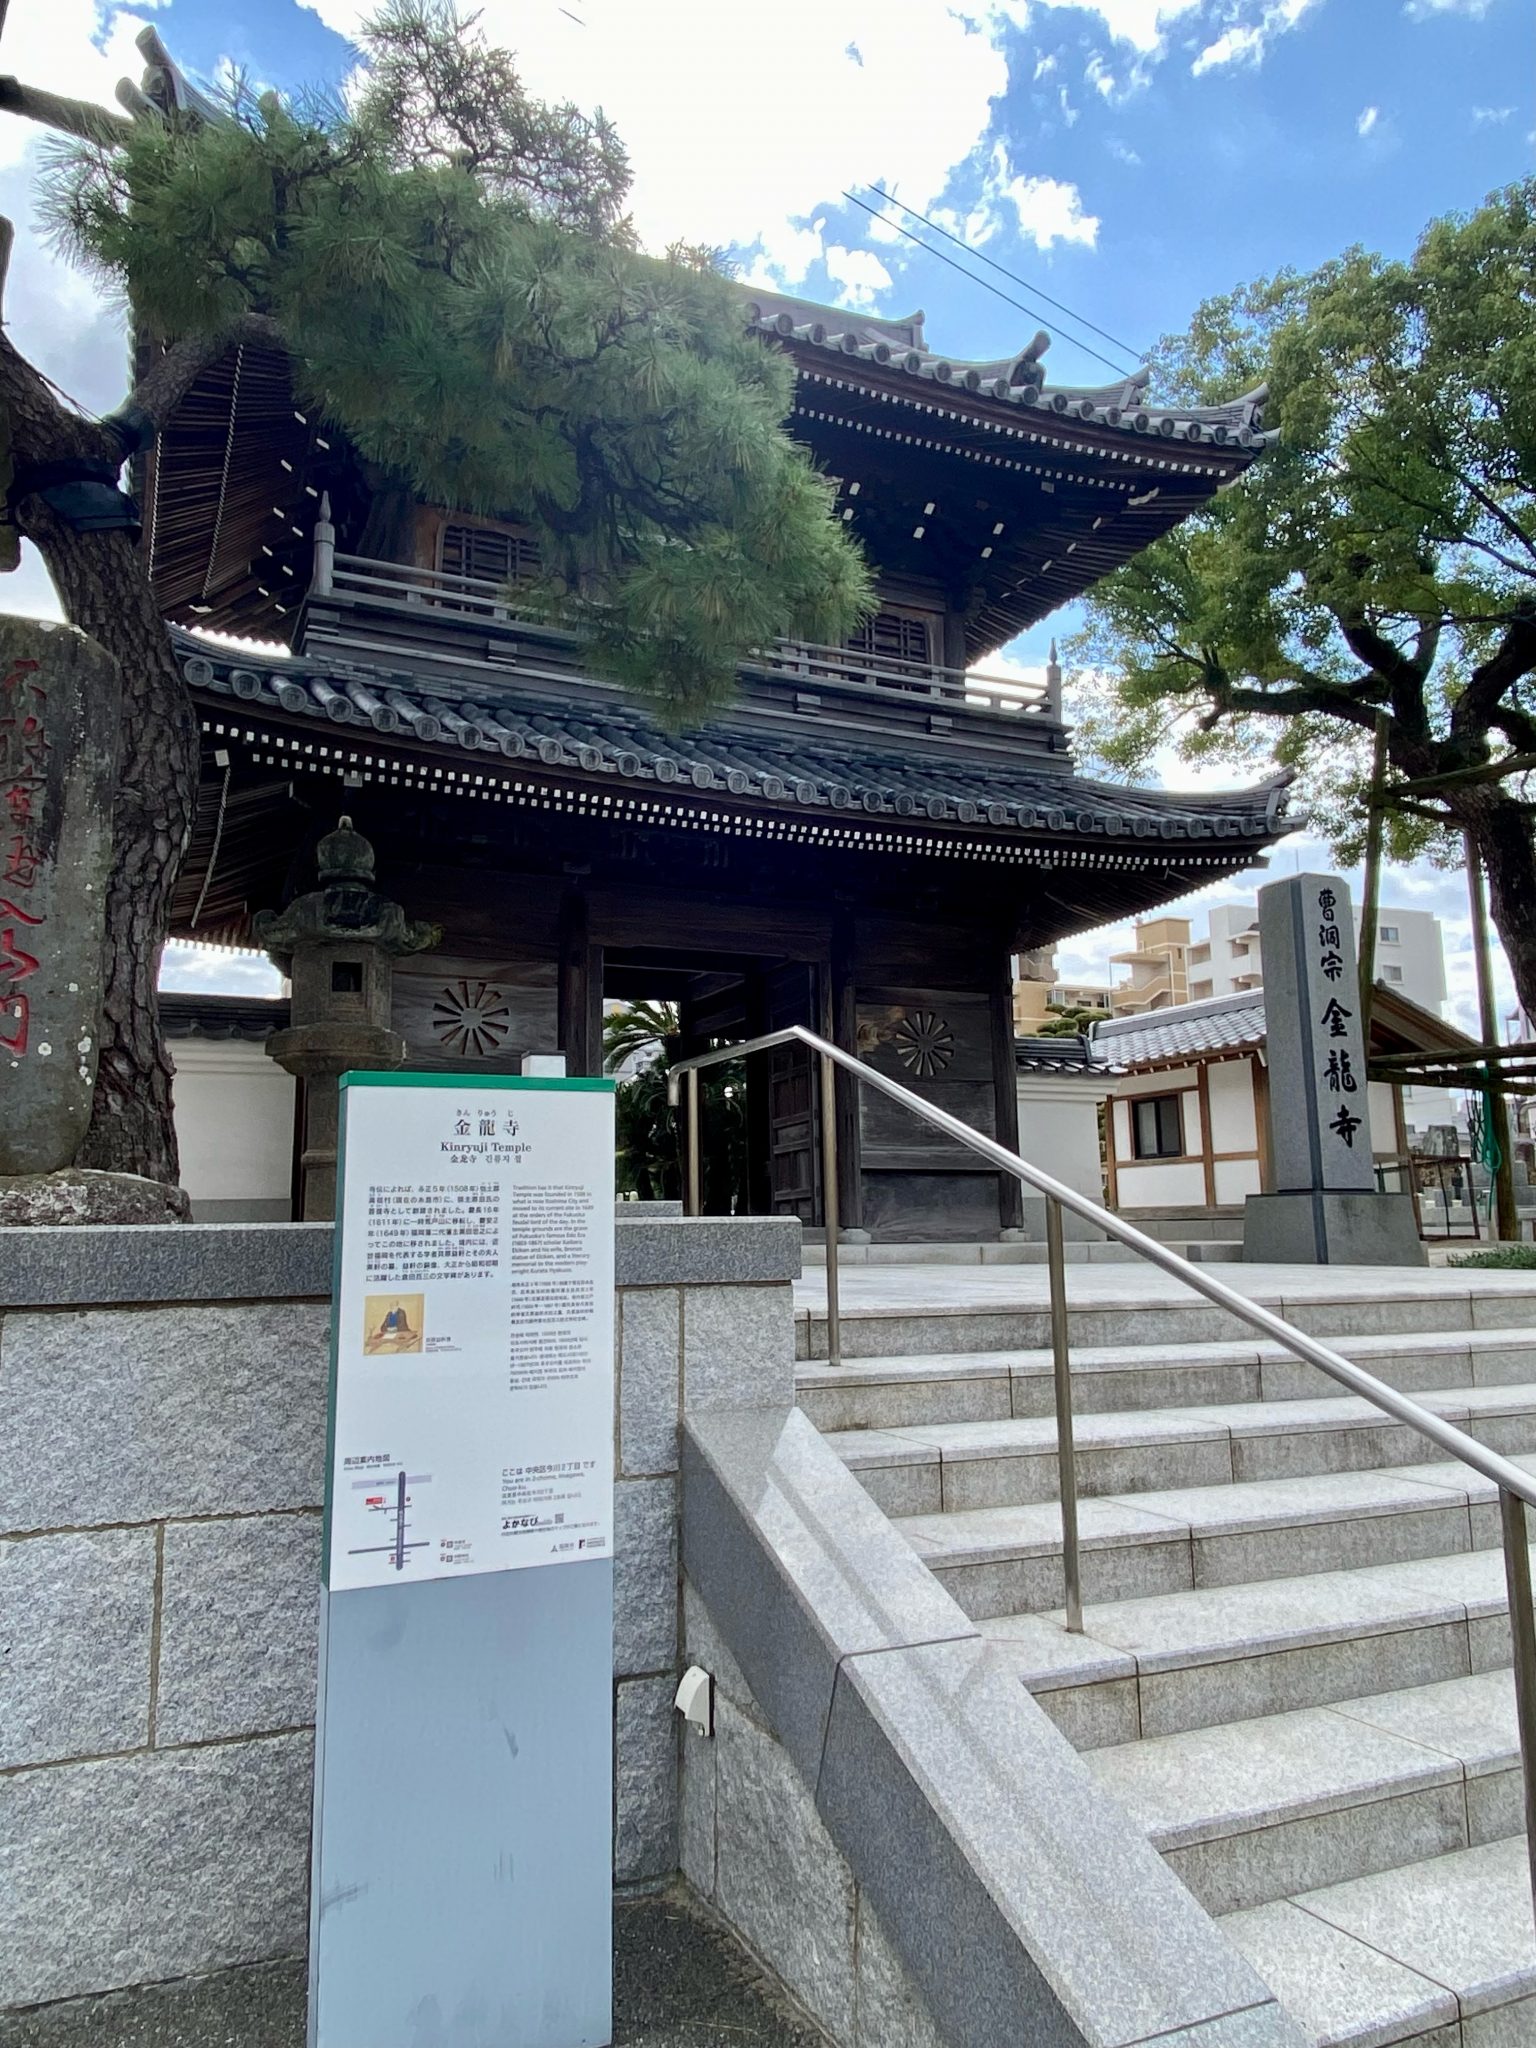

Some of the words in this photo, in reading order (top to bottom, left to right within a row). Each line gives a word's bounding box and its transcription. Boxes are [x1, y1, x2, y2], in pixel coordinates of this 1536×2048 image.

[1318, 887, 1345, 983] 曹洞宗
[1320, 997, 1362, 1149] 金龍寺
[440, 1142, 488, 1153] Kinryuji
[491, 1142, 532, 1153] Temple
[453, 1119, 519, 1136] 金龍寺
